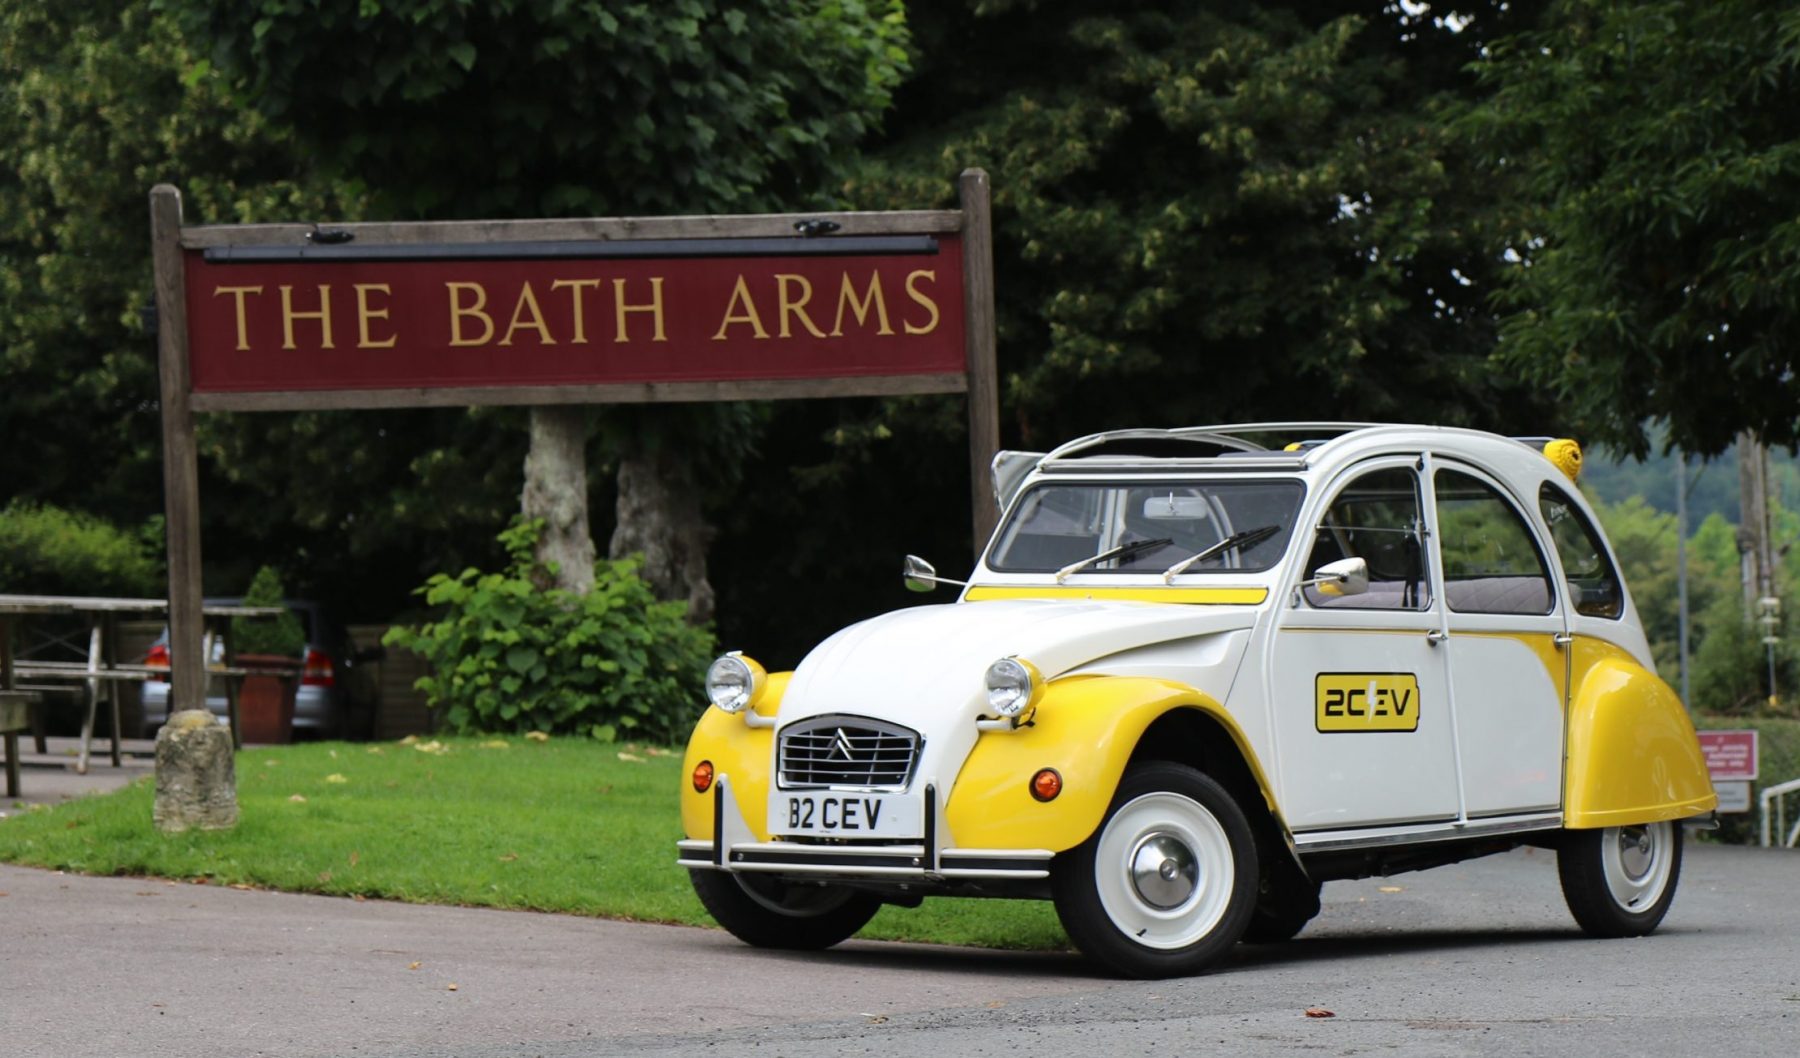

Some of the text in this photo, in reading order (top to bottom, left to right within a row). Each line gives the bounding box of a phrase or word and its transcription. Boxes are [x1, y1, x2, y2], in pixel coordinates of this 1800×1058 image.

[214, 269, 940, 351] THE BATH ARMS
[1325, 688, 1411, 717] 2CEV
[788, 797, 882, 830] B2 CEV
